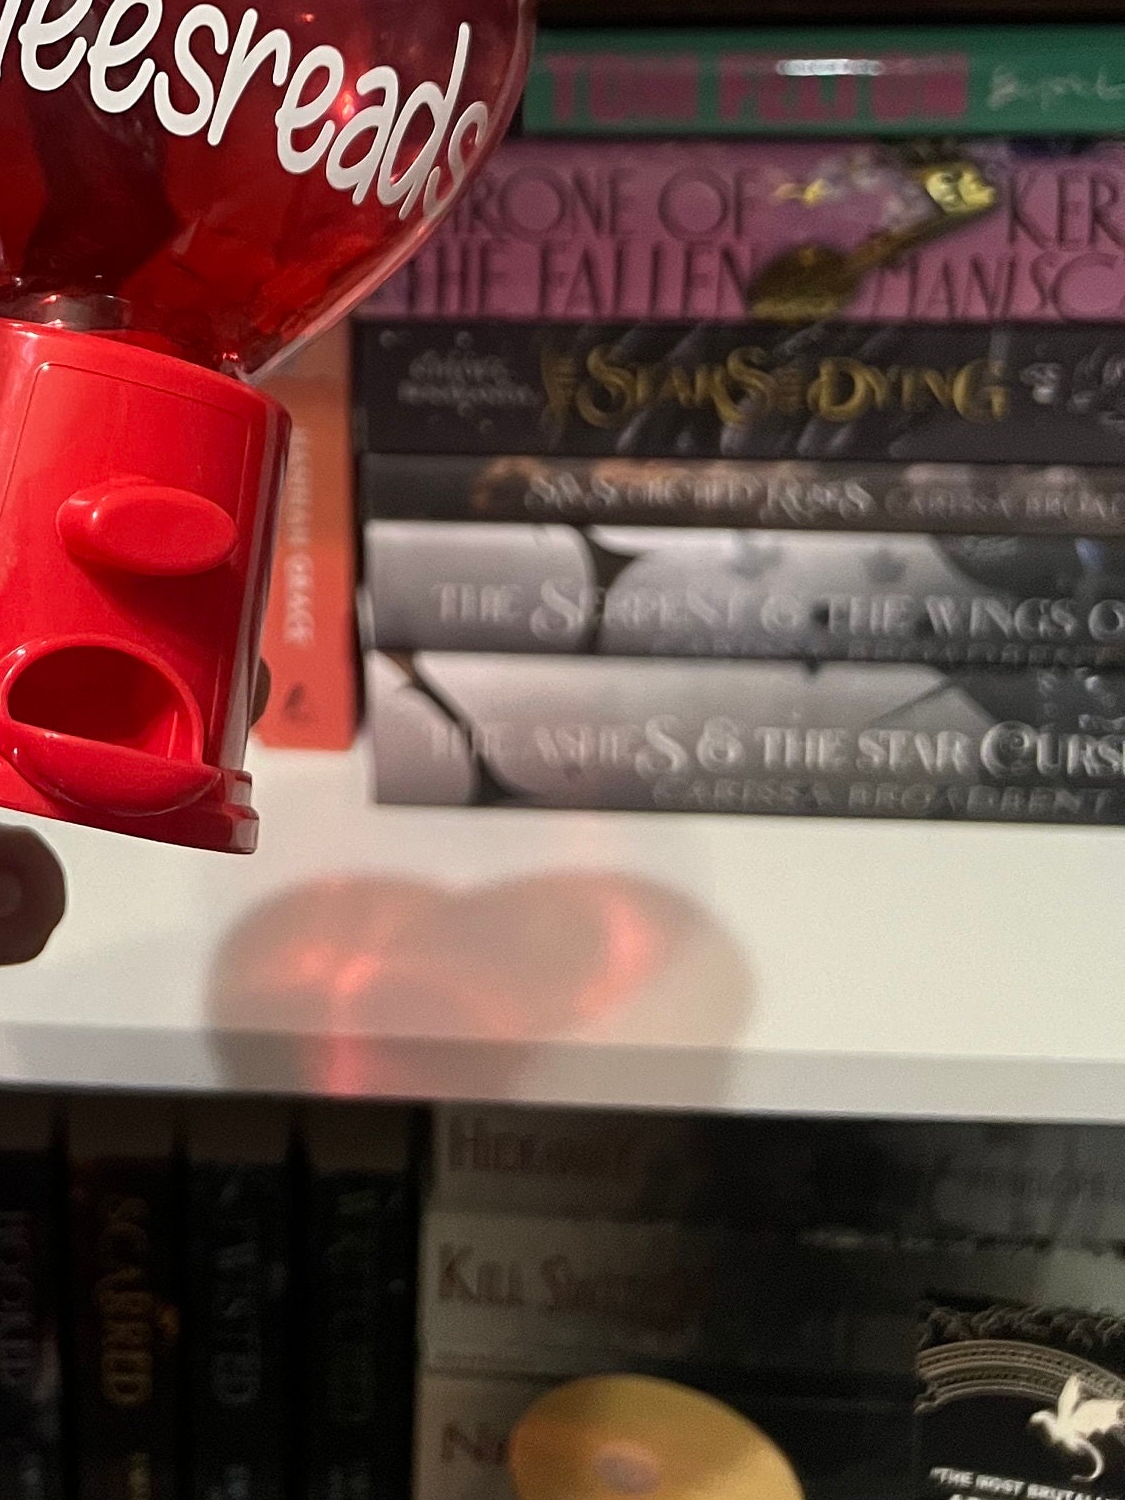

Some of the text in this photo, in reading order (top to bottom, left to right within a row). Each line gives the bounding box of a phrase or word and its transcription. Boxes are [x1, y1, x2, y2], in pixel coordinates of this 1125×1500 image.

[453, 164, 756, 242] RONE OF
[873, 252, 1125, 320] MANISC
[925, 595, 1075, 639] WINGS
[755, 726, 846, 773] THE
[857, 727, 972, 774] STAR
[980, 721, 1125, 779] CURS
